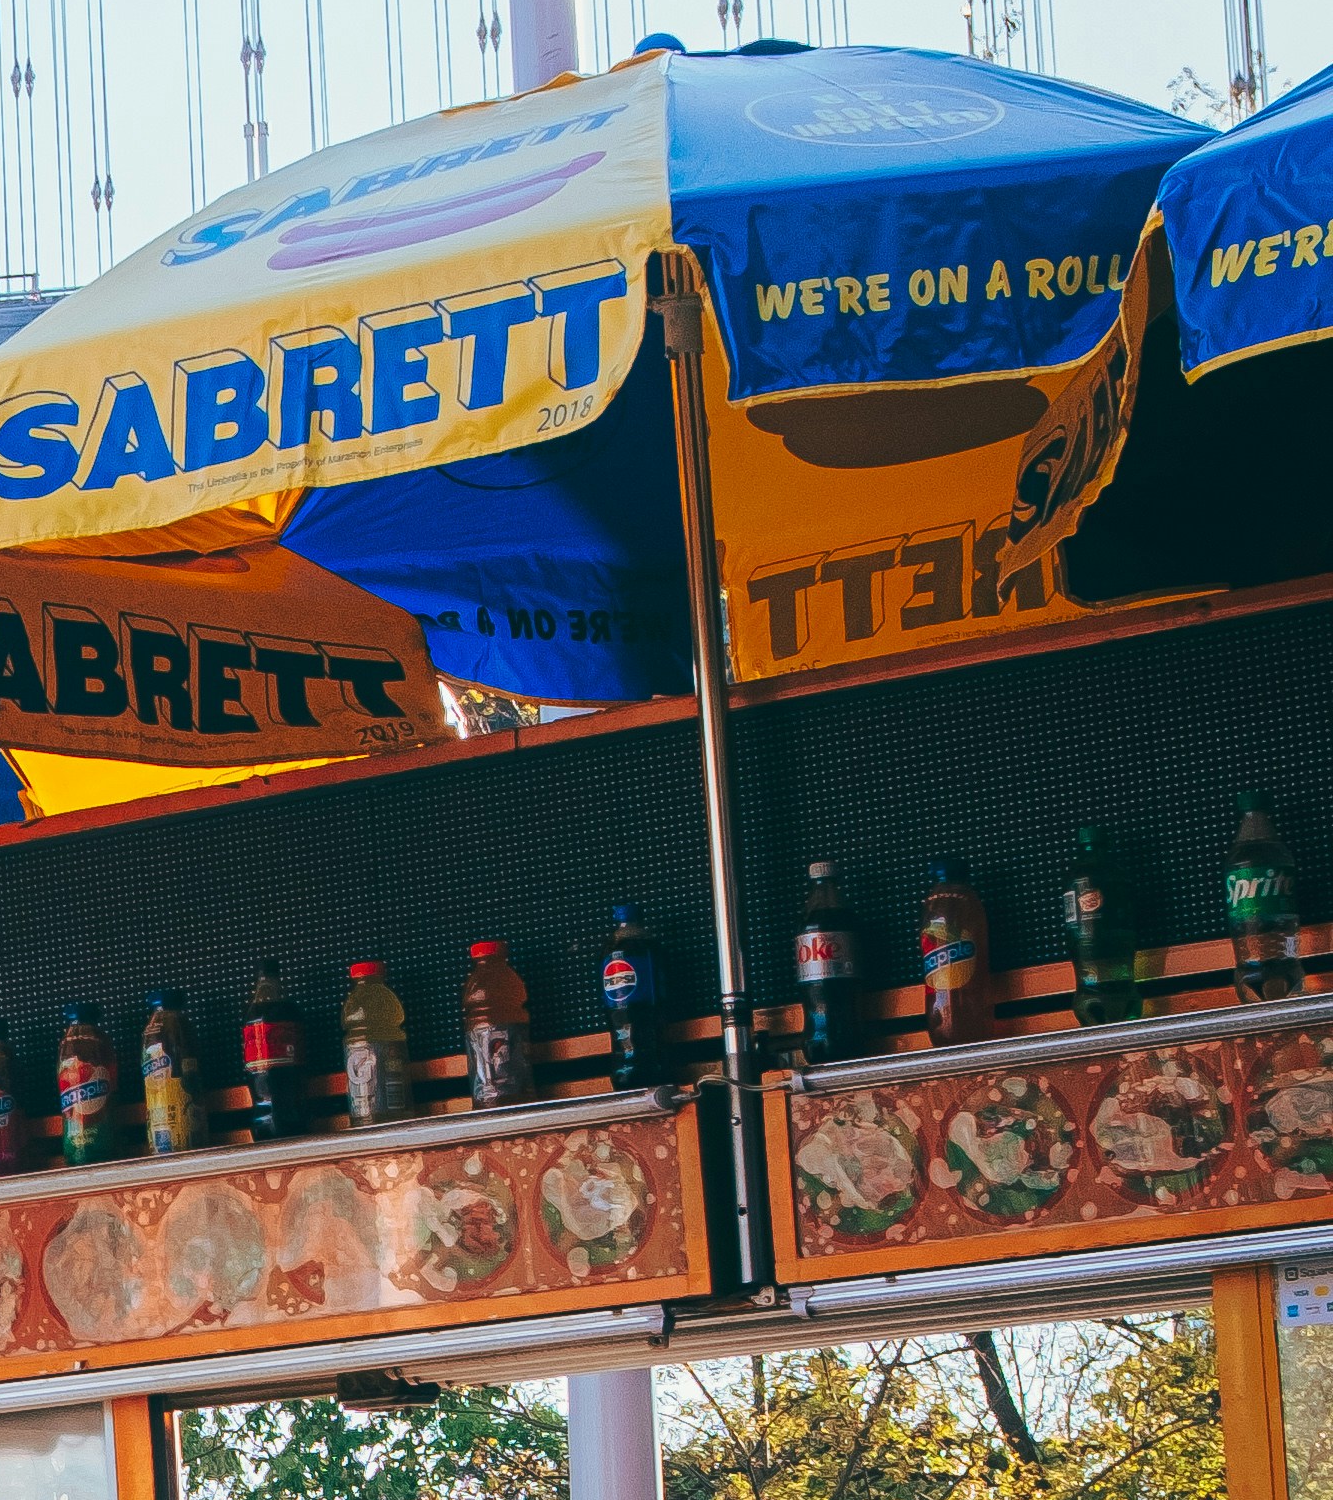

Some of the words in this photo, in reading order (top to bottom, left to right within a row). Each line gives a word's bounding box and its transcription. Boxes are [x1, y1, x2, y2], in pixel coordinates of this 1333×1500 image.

[161, 103, 629, 269] SABRETT
[755, 273, 891, 322] WE'RE
[908, 264, 969, 307] ON
[986, 259, 1012, 301] A
[1025, 254, 1125, 301] ROLL
[536, 394, 596, 435] 2018
[207, 471, 248, 488] Umbrella
[249, 470, 259, 478] is
[260, 465, 276, 477] the
[354, 720, 416, 747] 2019
[798, 937, 841, 964] oke
[925, 940, 976, 972] apple
[62, 1081, 109, 1111] napple
